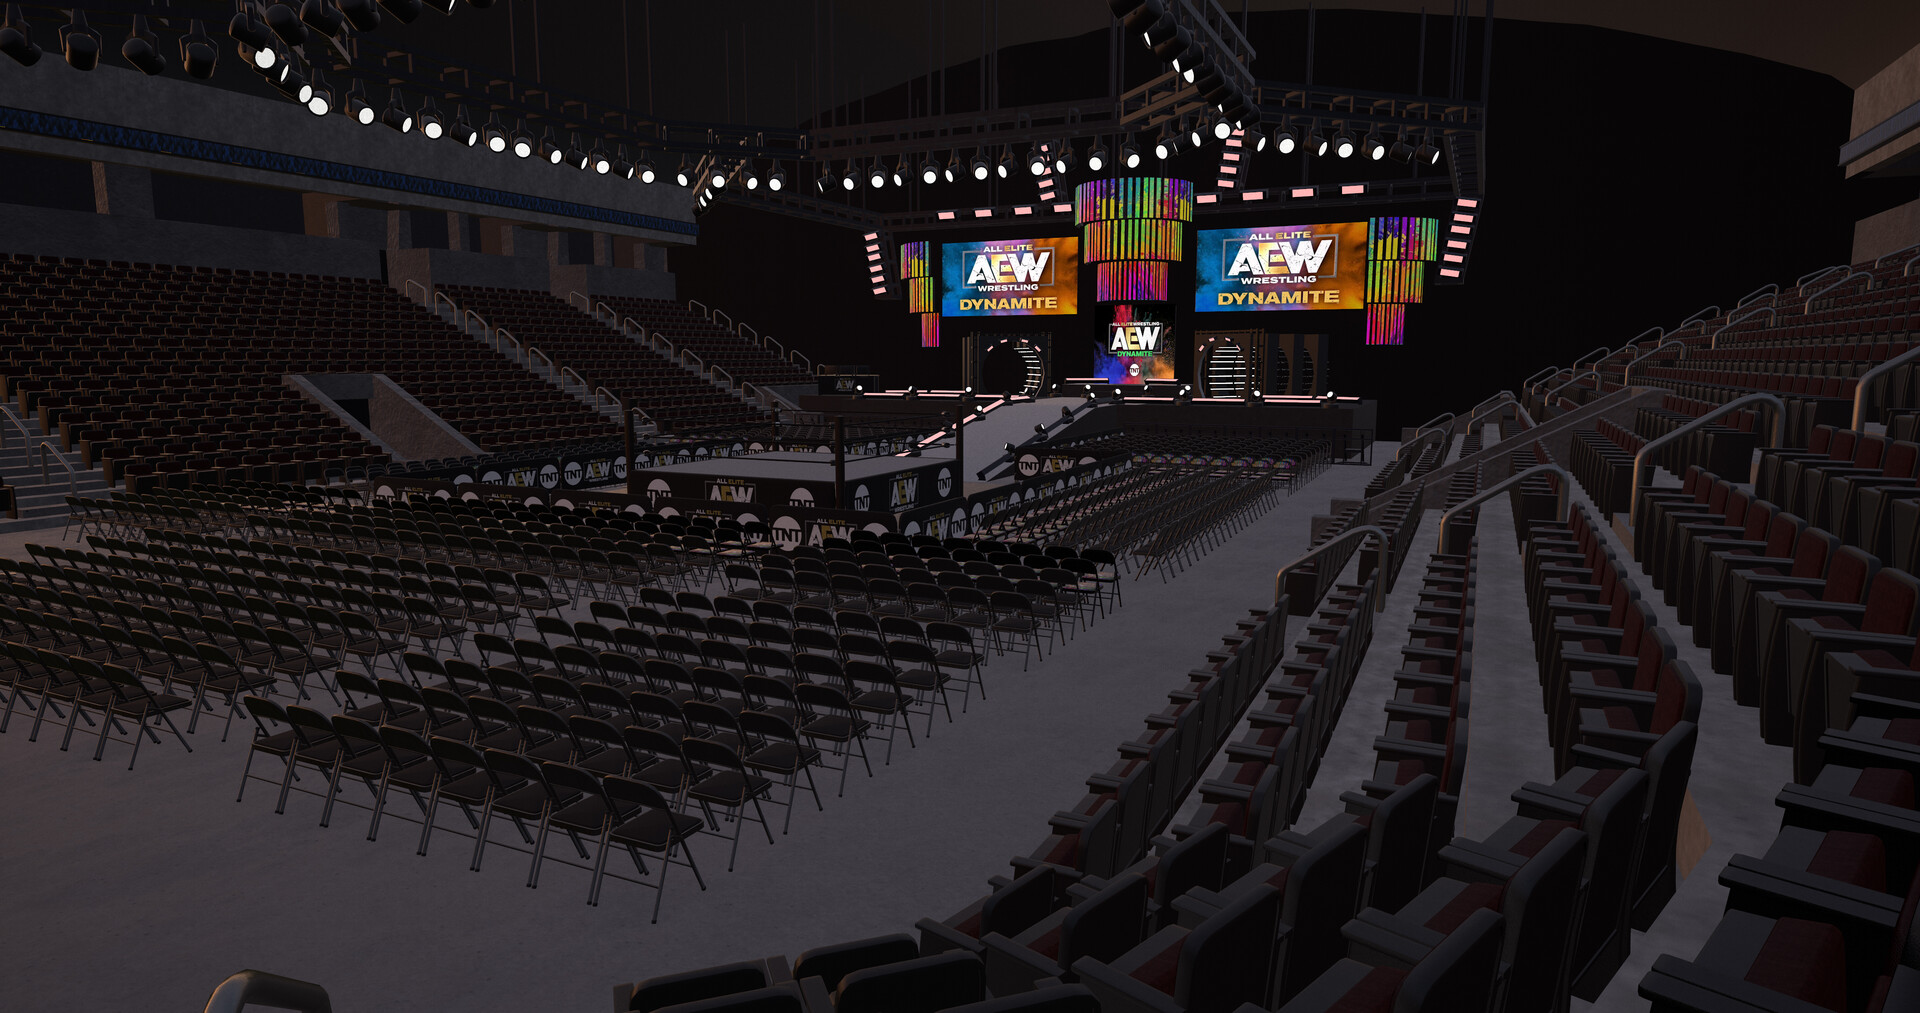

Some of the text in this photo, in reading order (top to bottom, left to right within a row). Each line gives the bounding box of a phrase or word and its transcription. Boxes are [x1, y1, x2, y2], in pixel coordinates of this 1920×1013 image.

[1249, 231, 1312, 240] ALL ELITE
[1228, 240, 1332, 276] AEW
[967, 252, 1050, 284] AEW
[978, 284, 1038, 292] WRESTLING
[1241, 276, 1316, 284] WRESTLING
[960, 297, 1057, 310] DYNAMITE
[1218, 290, 1340, 305] DYNAMITE
[1111, 327, 1160, 350] AEW
[586, 462, 611, 478] AEW
[1042, 459, 1074, 472] AEW
[507, 470, 536, 487] AEW
[710, 485, 754, 503] AEW
[891, 477, 917, 508] AEW
[926, 516, 949, 542] AEW
